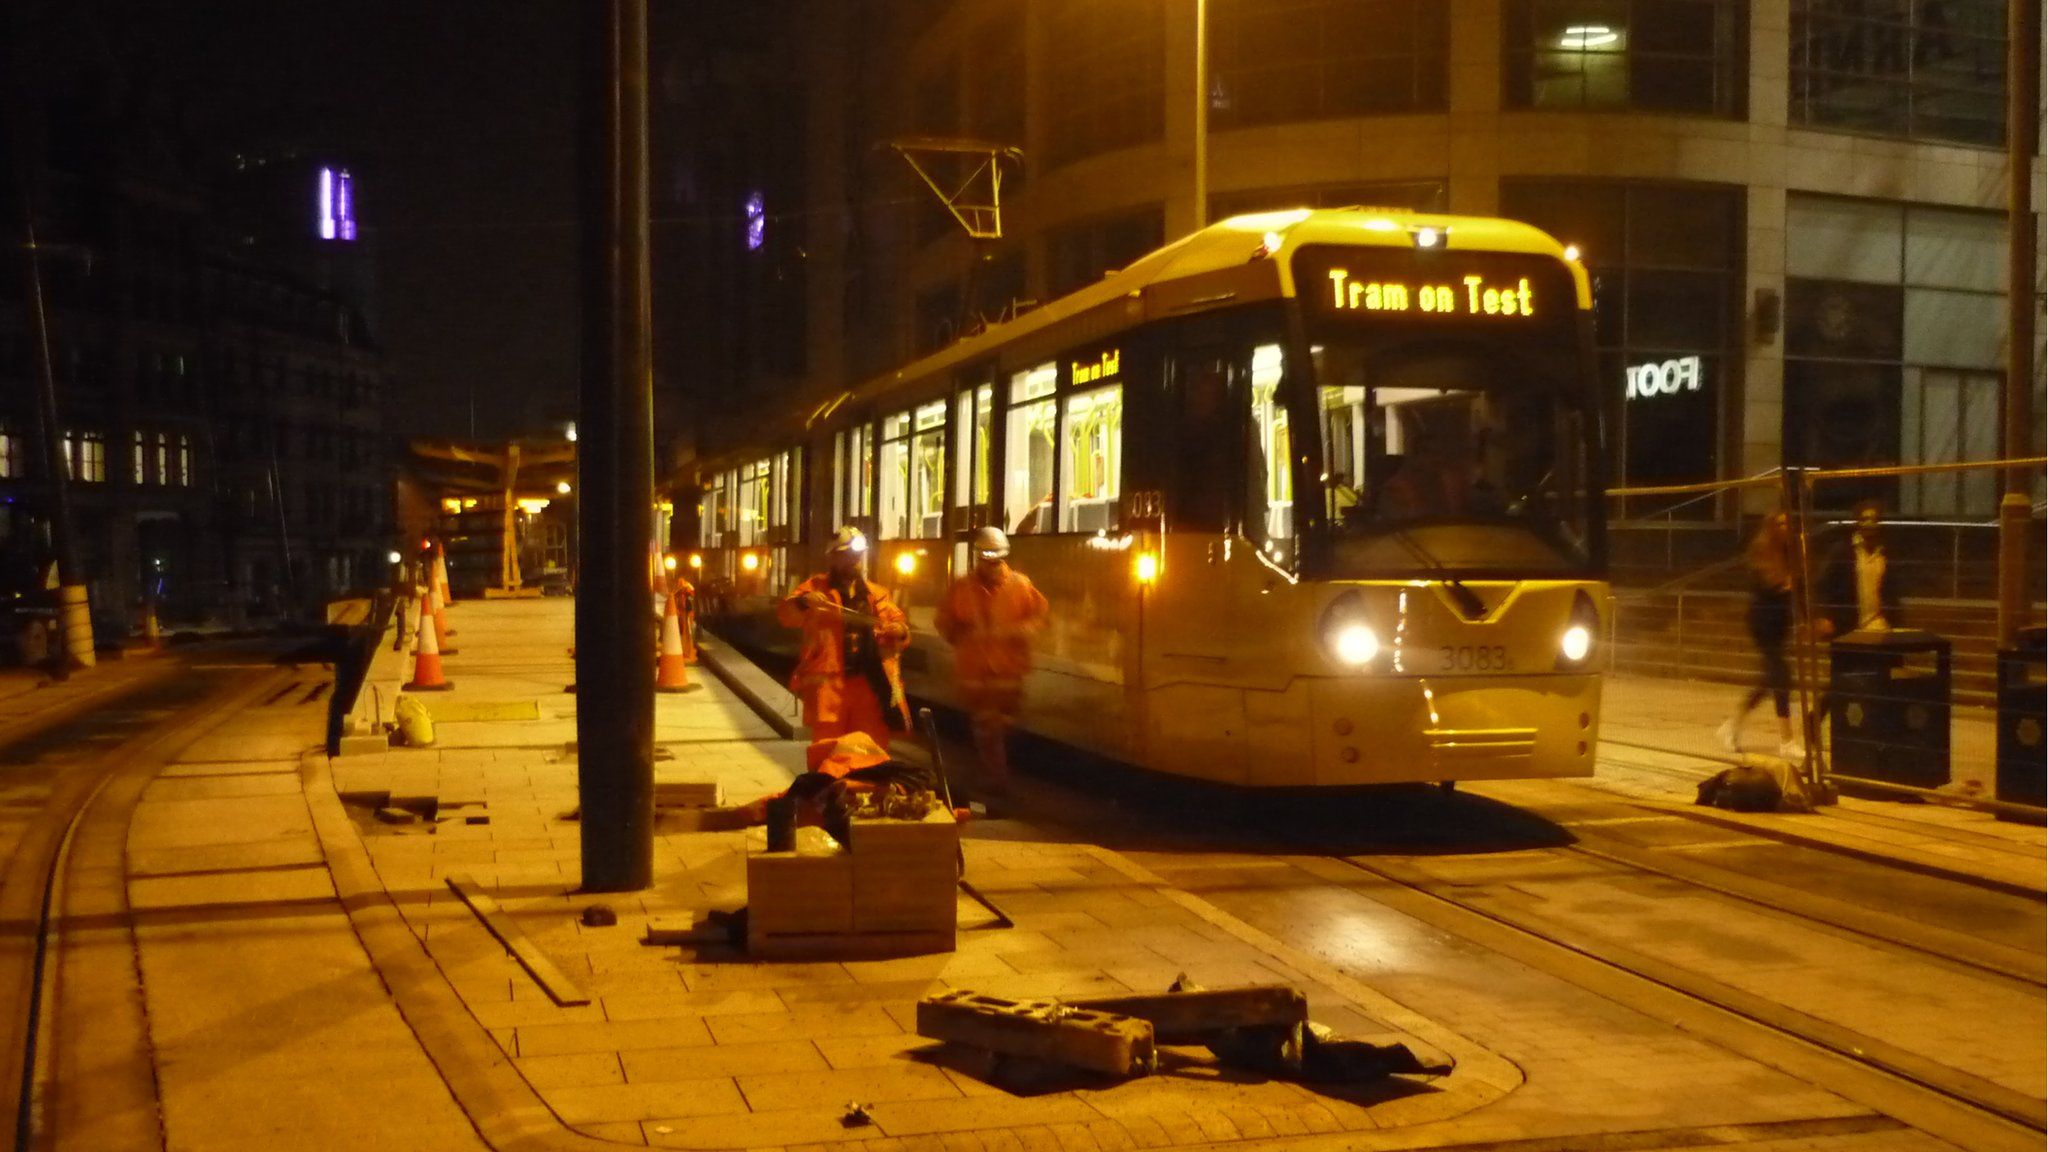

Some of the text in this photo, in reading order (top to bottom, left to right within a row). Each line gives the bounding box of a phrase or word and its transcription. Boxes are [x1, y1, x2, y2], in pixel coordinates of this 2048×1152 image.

[1329, 269, 1534, 316] Tram on Test
